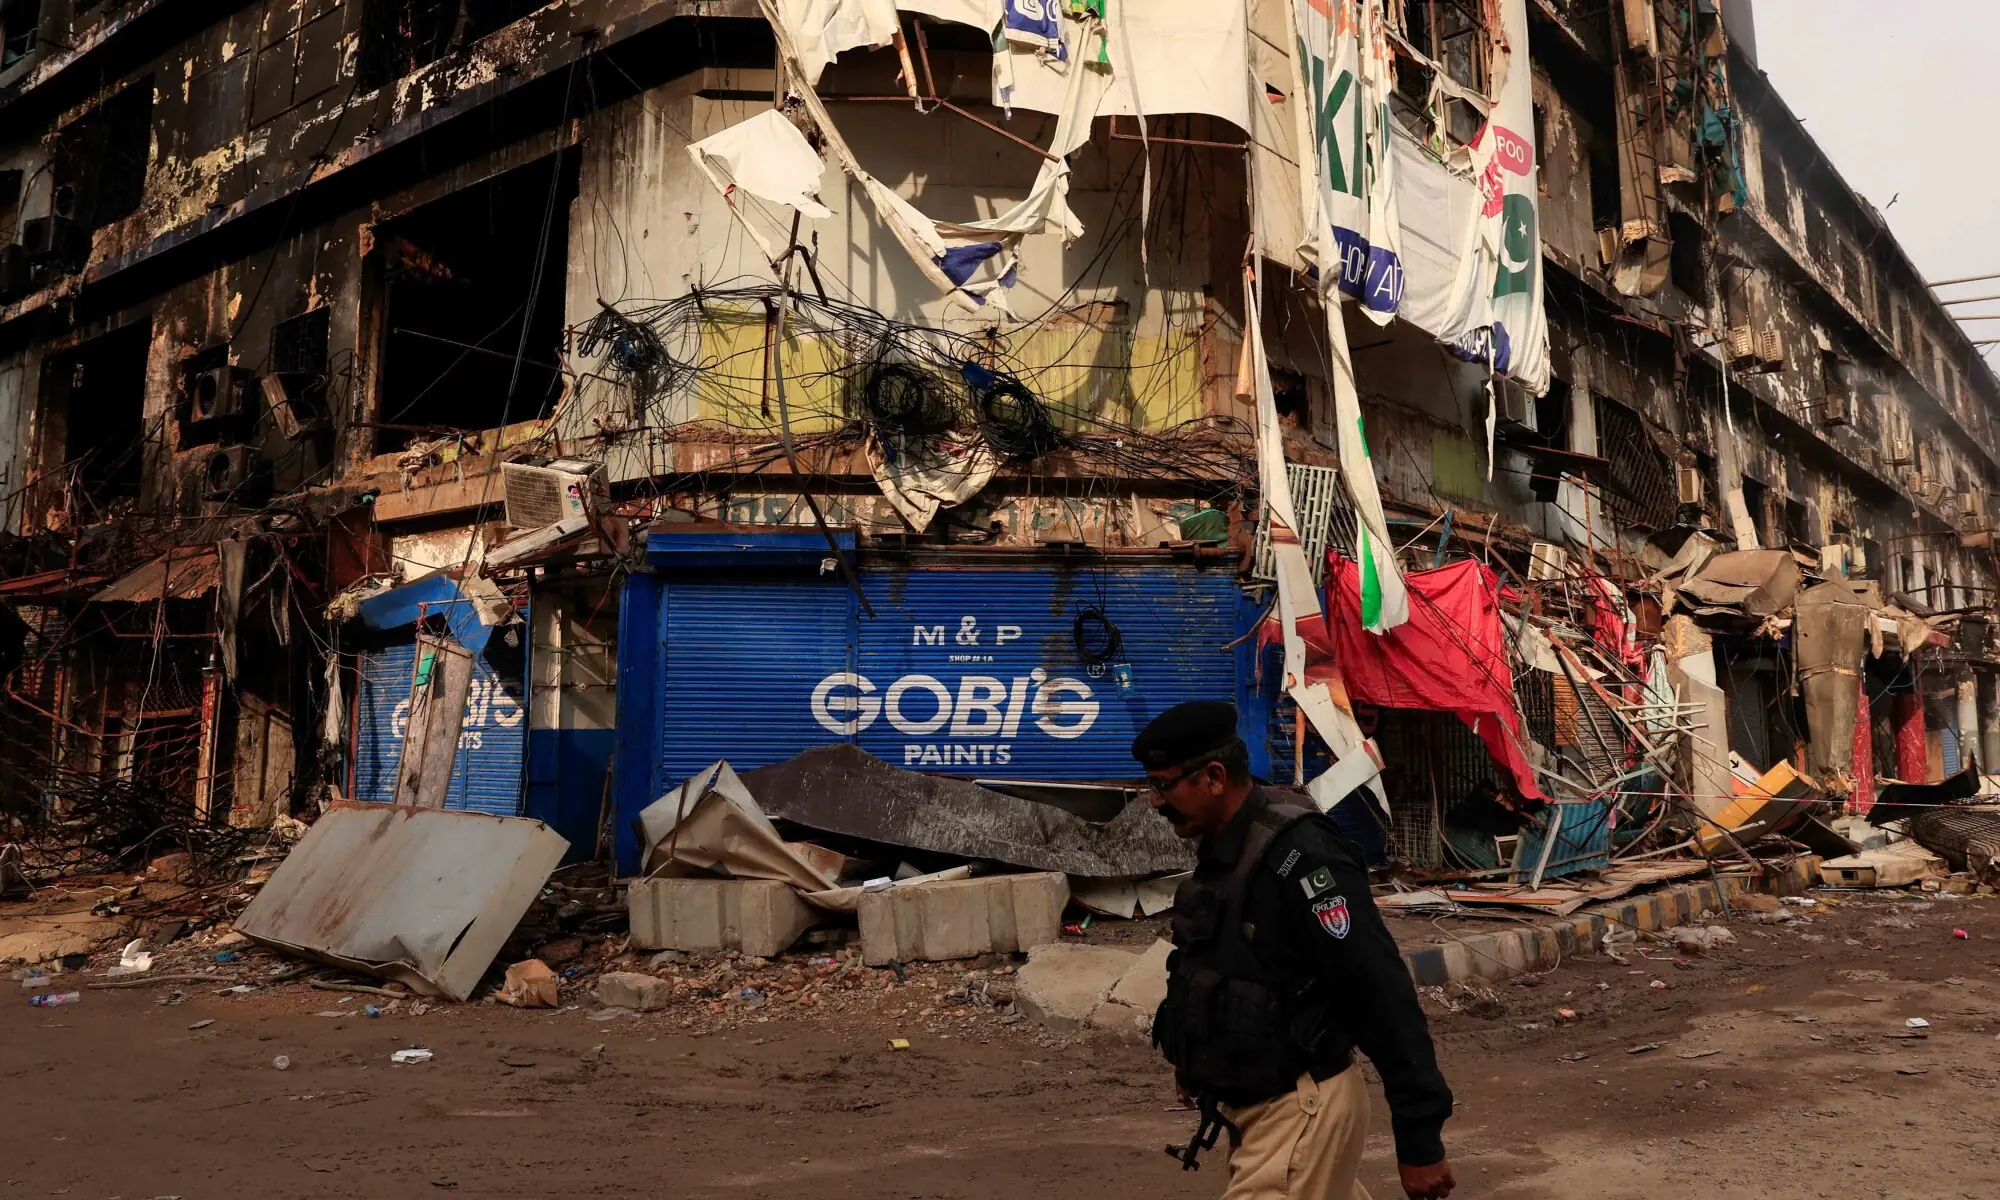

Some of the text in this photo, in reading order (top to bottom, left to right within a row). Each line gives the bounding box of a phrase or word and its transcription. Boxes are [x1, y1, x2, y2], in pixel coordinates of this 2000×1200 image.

[913, 616, 1023, 646] M & P
[904, 744, 1011, 765] PAINTS
[1316, 898, 1343, 913] POLICE
